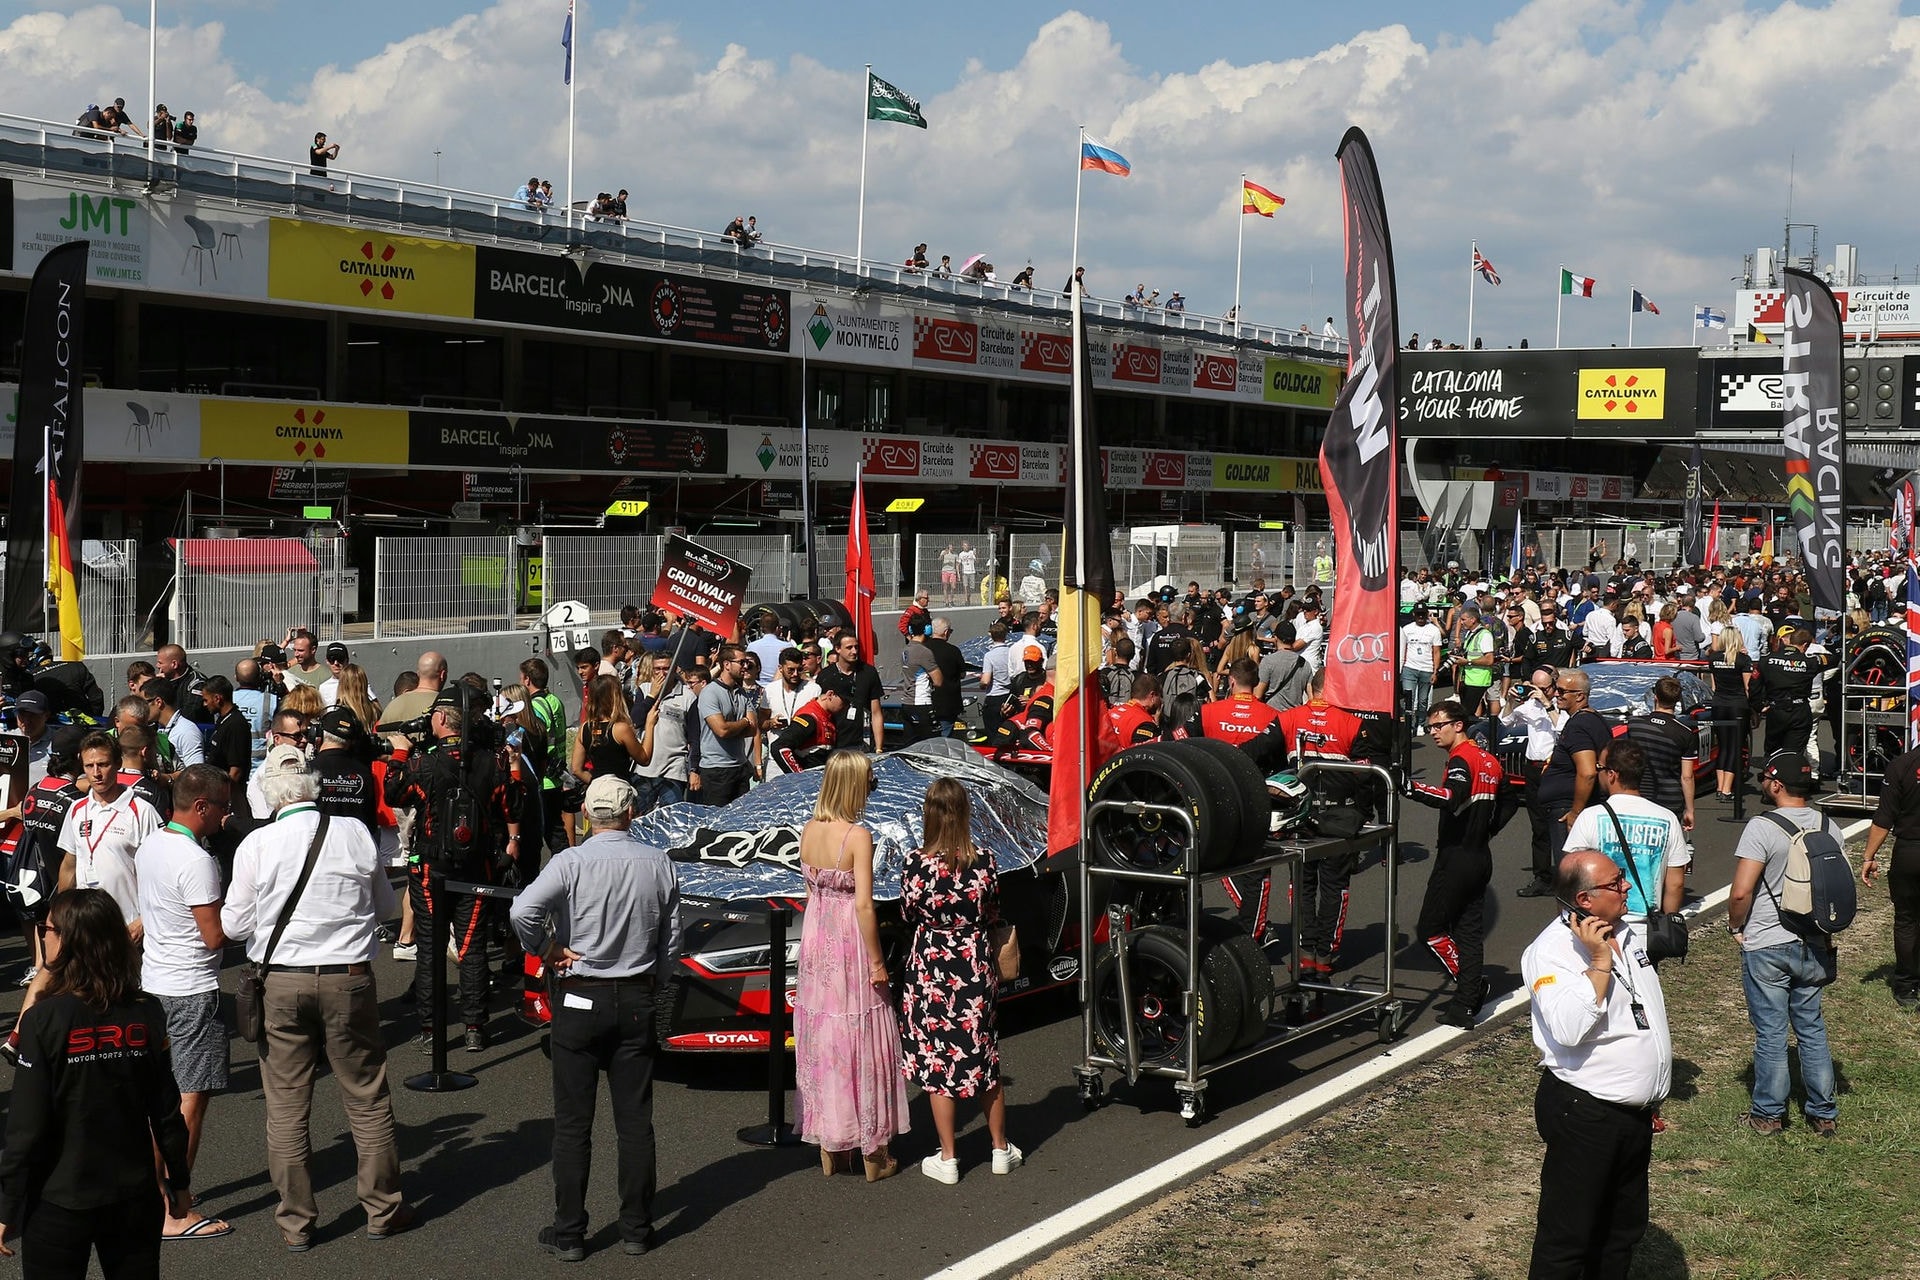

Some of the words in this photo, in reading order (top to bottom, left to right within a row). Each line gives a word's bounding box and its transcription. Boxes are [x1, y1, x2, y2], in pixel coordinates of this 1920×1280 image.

[60, 192, 136, 236] JMT
[22, 242, 44, 252] RENTAL
[339, 259, 415, 281] CATALUNYA
[490, 270, 634, 308] BARCELONA
[656, 287, 677, 303] VINYL
[1855, 290, 1893, 301] Circuit
[1896, 290, 1910, 300] de
[565, 296, 602, 316] inspira
[765, 302, 783, 316] VINYL
[1856, 302, 1909, 312] Barelona
[653, 308, 679, 328] PROJECT
[836, 314, 887, 333] AJUNTAMENT
[888, 321, 900, 333] DE
[1854, 313, 1909, 322] CATLUNYA
[763, 322, 785, 340] PROJECT
[981, 325, 1003, 340] Circuit
[1004, 330, 1015, 341] de
[836, 331, 899, 352] MONTMELÓ
[980, 341, 1015, 356] Barcelona
[52, 279, 71, 439] FALCON
[980, 357, 1014, 369] CATALUNYA
[1163, 351, 1181, 363] Circuit
[1182, 353, 1190, 364] de
[1163, 363, 1190, 376] Barcelona
[1238, 360, 1254, 372] Circuit
[1255, 363, 1263, 373] de
[1162, 375, 1189, 387] CATALUNYA
[1238, 372, 1263, 385] Barcelona
[1273, 371, 1321, 395] GOLDCAR
[1411, 369, 1502, 394] CATALONIA
[1585, 389, 1657, 398] CATALUNYA
[1414, 396, 1461, 423] YOUR
[1466, 395, 1524, 421] HOME
[275, 425, 343, 440] CATALUNYA
[441, 428, 554, 449] BARCELONA
[499, 444, 528, 457] inspira
[779, 443, 820, 453] AJUNTAENT
[821, 445, 829, 453] DE
[923, 442, 945, 453] Circuit
[946, 444, 954, 454] de
[1022, 447, 1042, 458] Circuit
[1043, 449, 1049, 459] de
[779, 455, 829, 467] MONTELÓ
[922, 455, 954, 466] Barcelona
[1110, 450, 1128, 462] Circuit
[1129, 453, 1137, 462] de
[1188, 454, 1204, 465] Circuit
[1204, 456, 1212, 466] de
[1022, 459, 1049, 471] Barcelona
[1110, 463, 1137, 474] Barcelona
[1187, 466, 1212, 477] Barcelona
[275, 468, 296, 481] 991
[465, 473, 478, 485] 911
[922, 469, 954, 477] CATALUNYA
[1021, 471, 1049, 481] CATALUNYA
[1225, 464, 1269, 482] GOLDCAR
[1110, 475, 1137, 485] CATALUNYA
[621, 502, 639, 513] 911
[684, 550, 724, 572] BLANCPAIN
[696, 563, 715, 577] SERIES
[667, 566, 697, 588] GRID
[697, 580, 736, 606] WALK
[669, 584, 709, 607] FOLLOW
[708, 601, 725, 615] ME
[563, 605, 574, 623] 2
[532, 636, 539, 654] 2
[553, 636, 566, 649] 76
[574, 633, 589, 645] 44
[1356, 712, 1379, 720] FFICIAL
[1219, 722, 1260, 734] TOTAL
[1088, 758, 1123, 802] PIRELLI
[728, 912, 750, 921] WRT
[1050, 959, 1079, 973] GrafiWrap
[1014, 977, 1030, 990] R8
[67, 1023, 148, 1054] SRO
[705, 1033, 760, 1044] TOTAL
